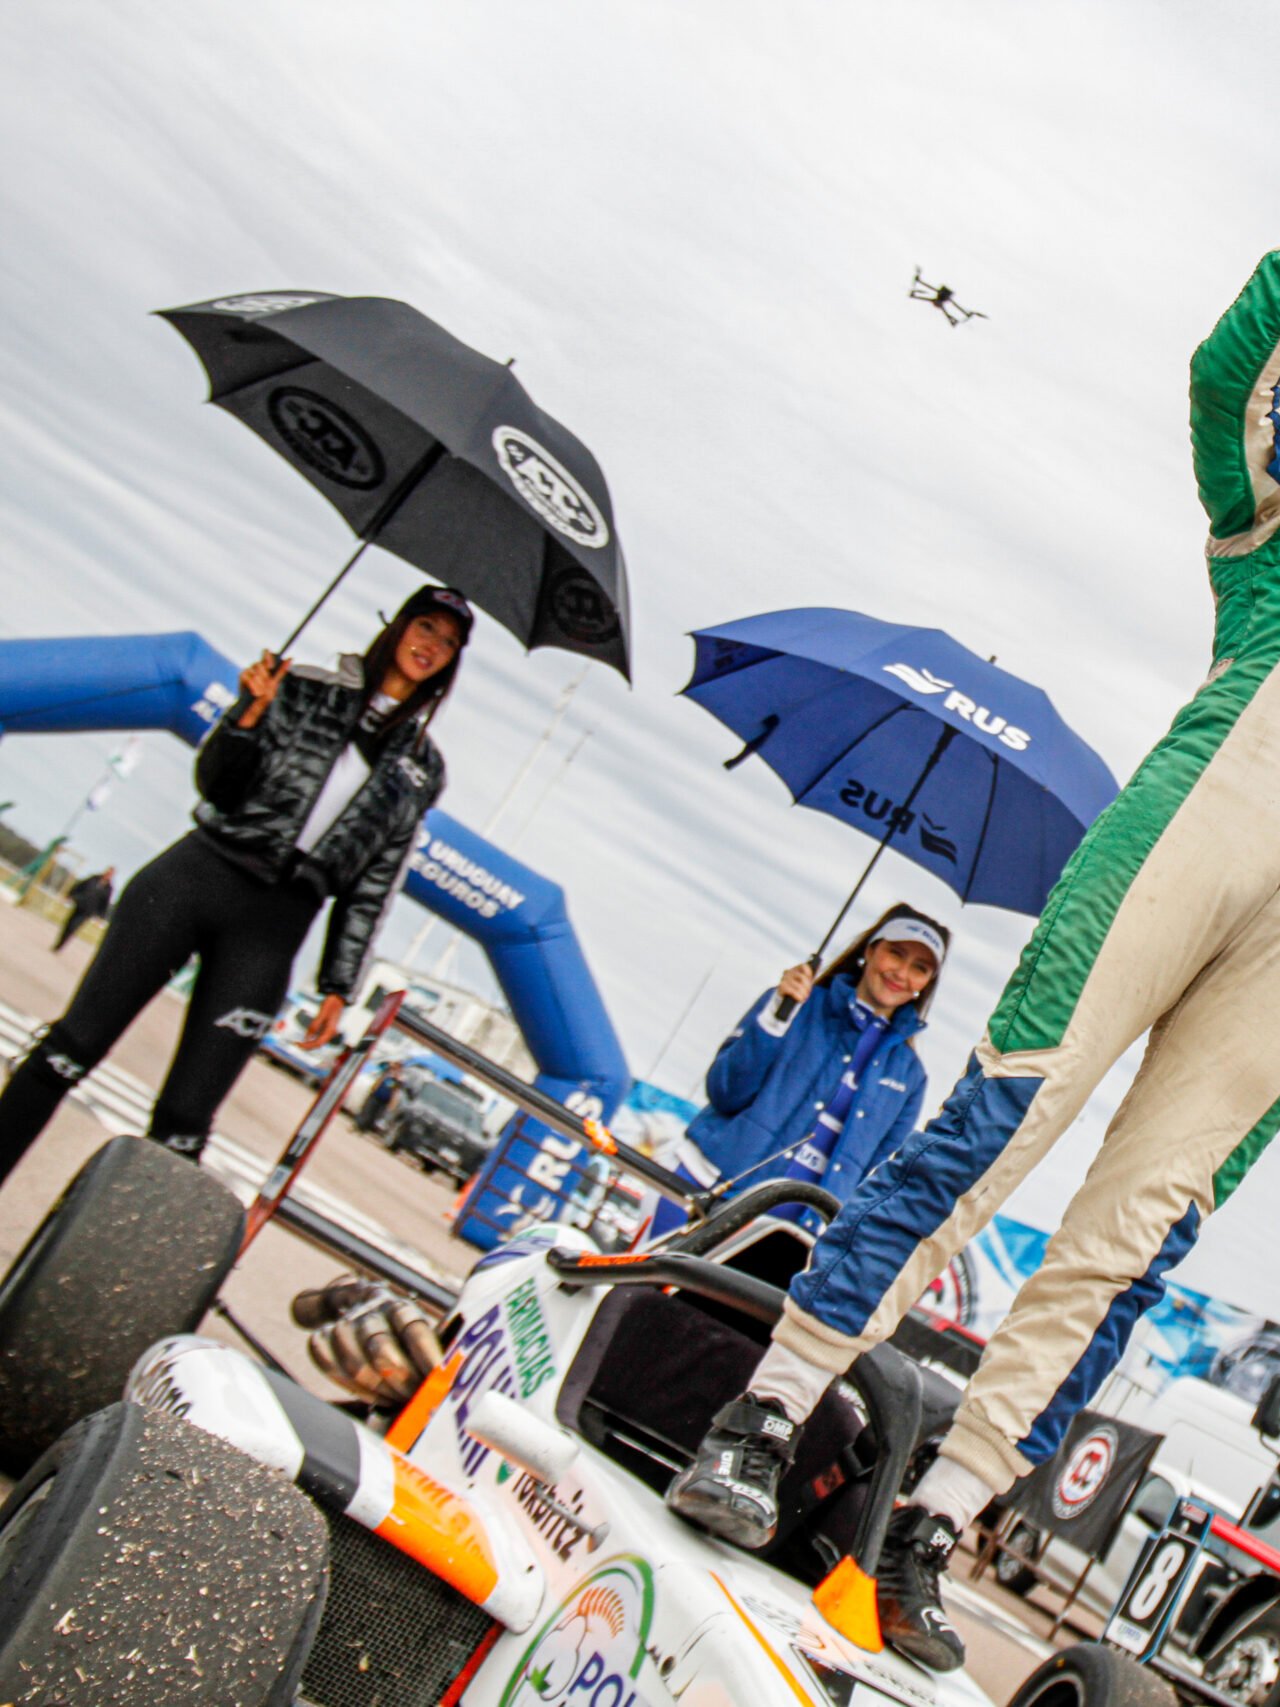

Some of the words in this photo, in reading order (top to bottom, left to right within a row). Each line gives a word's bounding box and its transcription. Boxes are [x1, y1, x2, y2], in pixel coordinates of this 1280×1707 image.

[943, 688, 1032, 752] RUS
[408, 850, 500, 919] EGUROS
[428, 840, 526, 910] URUGUAY
[504, 1276, 556, 1400] FARMACIAS
[762, 1418, 794, 1437] OMP
[1129, 1541, 1187, 1621] 8
[568, 1650, 637, 1707] PO
